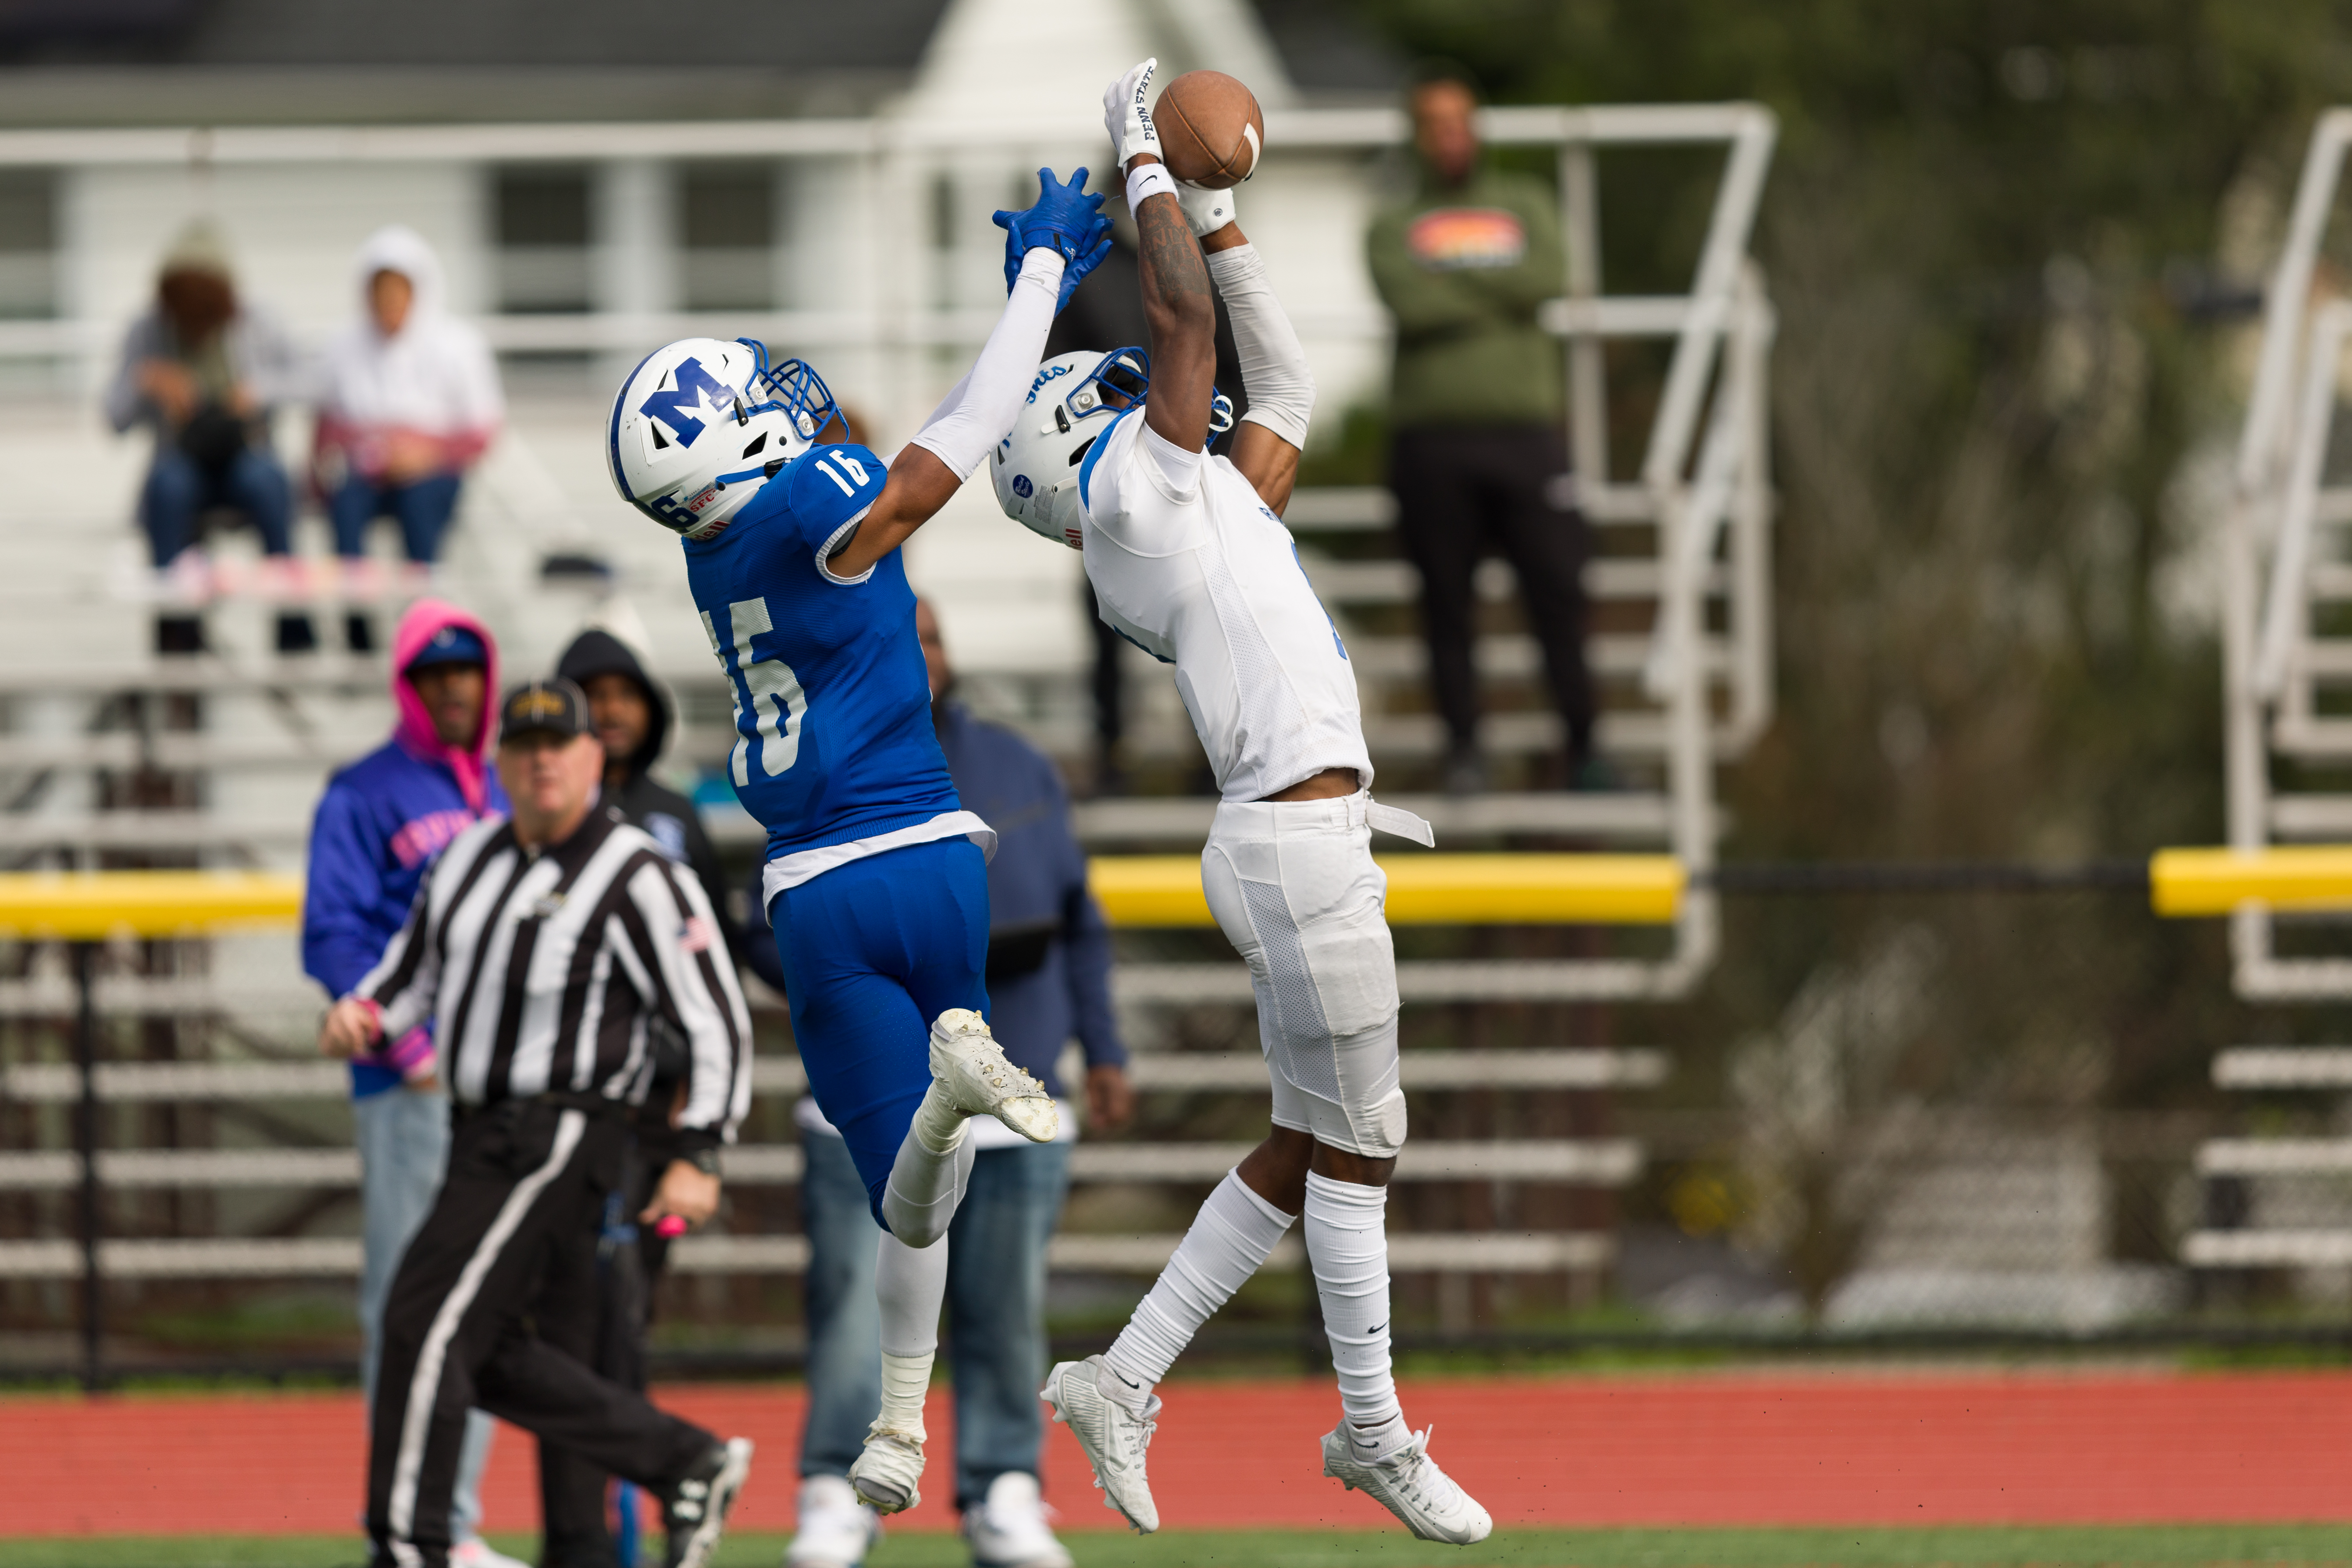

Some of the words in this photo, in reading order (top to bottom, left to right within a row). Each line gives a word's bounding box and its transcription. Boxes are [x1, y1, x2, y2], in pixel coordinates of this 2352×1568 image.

[1135, 65, 1154, 104] STATE
[1137, 107, 1155, 141] PENN
[639, 356, 738, 449] M
[814, 449, 871, 498] 16
[651, 495, 700, 528] 6
[700, 596, 808, 787] 16
